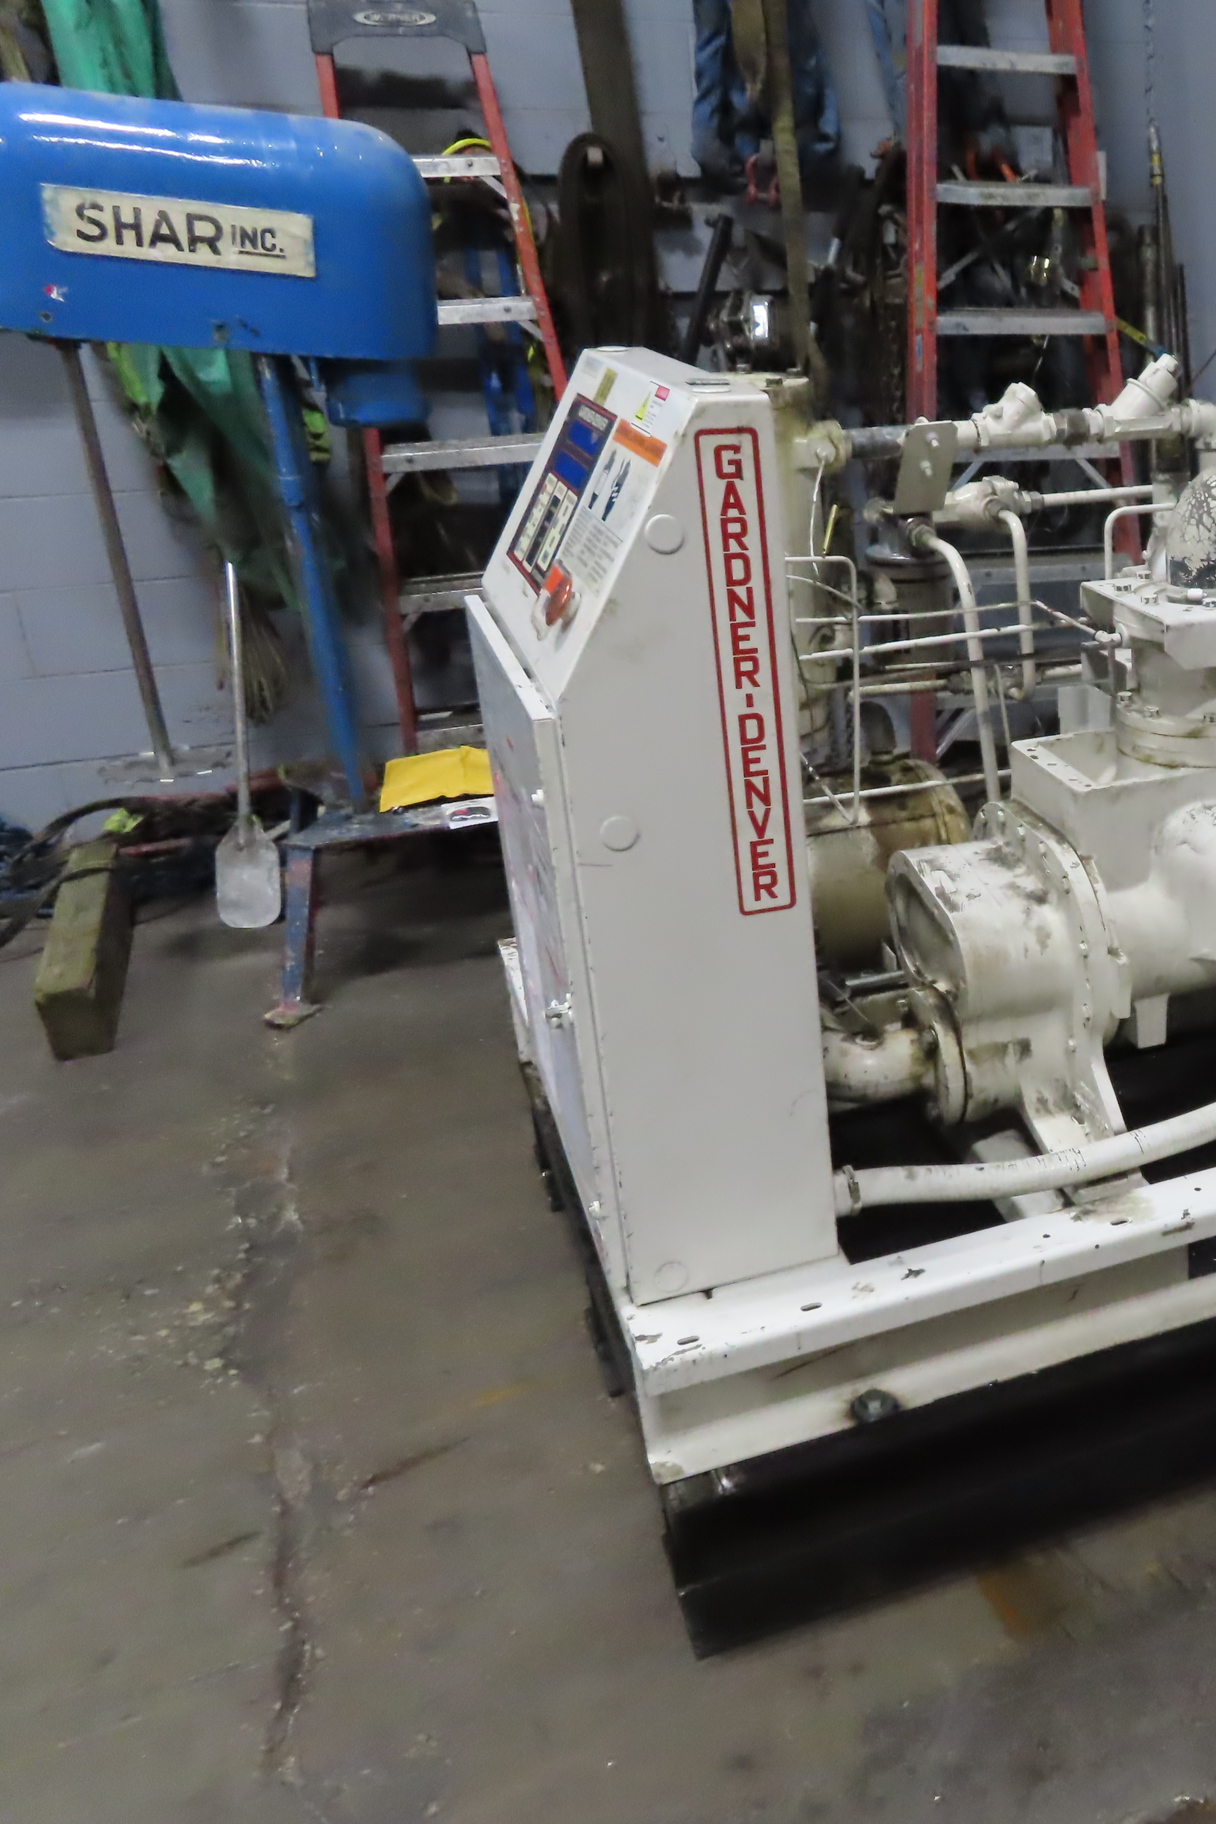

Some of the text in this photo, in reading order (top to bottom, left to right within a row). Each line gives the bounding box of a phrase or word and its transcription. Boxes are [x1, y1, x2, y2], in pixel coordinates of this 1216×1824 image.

[75, 201, 285, 256] SHAR INC.
[713, 444, 779, 902] GARDNER-DENVER
